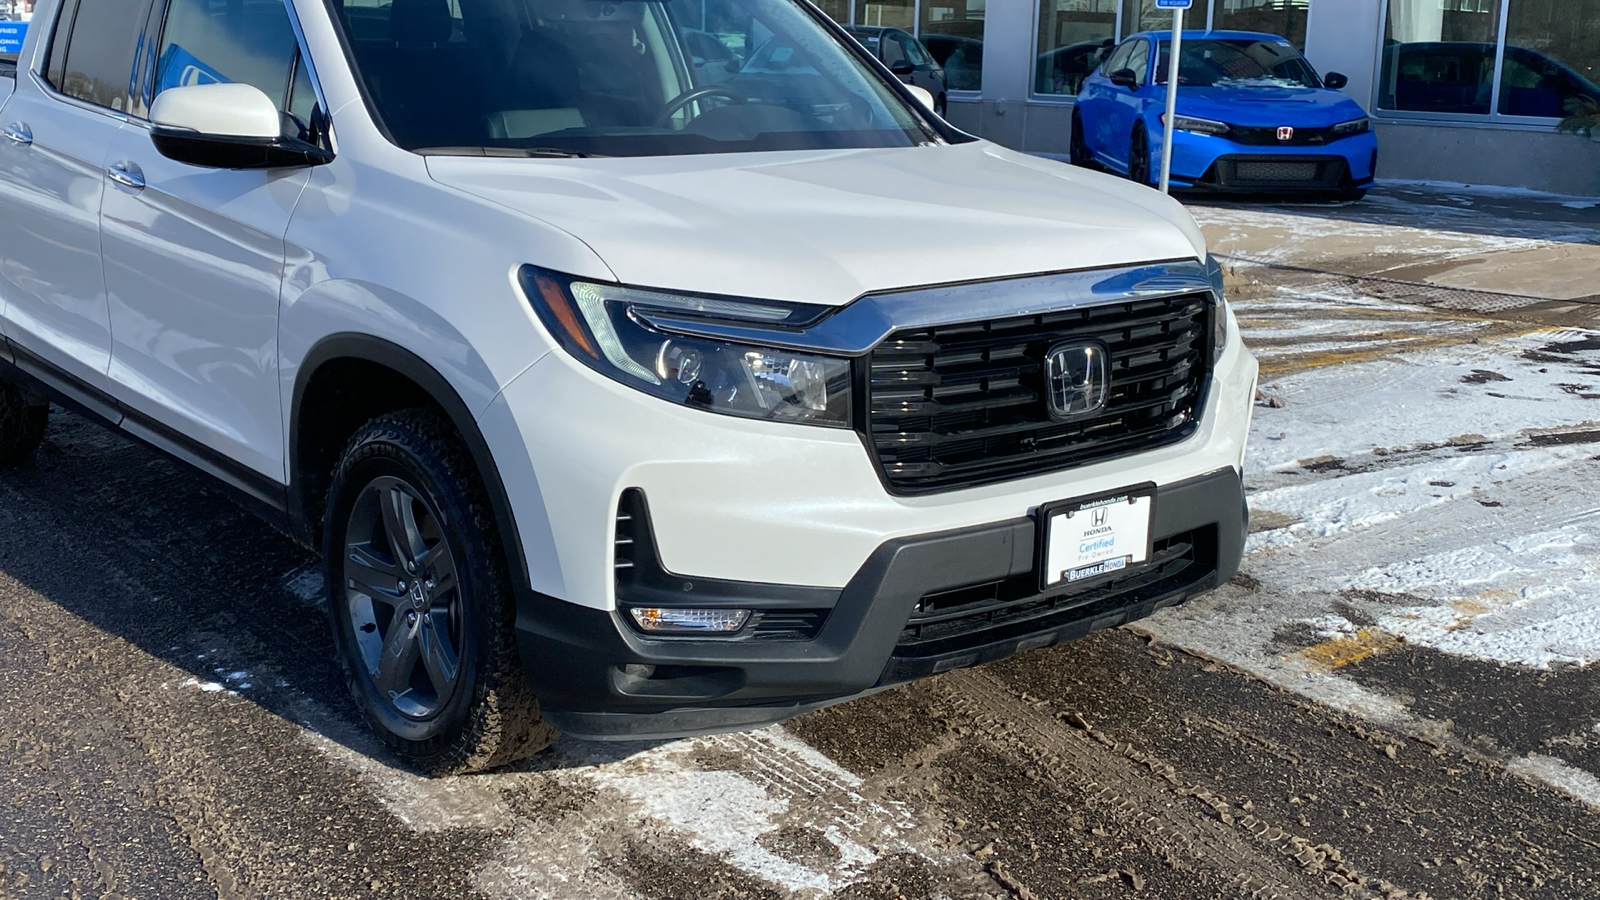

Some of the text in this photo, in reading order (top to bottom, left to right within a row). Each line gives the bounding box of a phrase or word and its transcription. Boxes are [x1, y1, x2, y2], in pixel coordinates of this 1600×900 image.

[1083, 526, 1112, 537] HONDA
[1079, 536, 1115, 553] Certified
[1070, 560, 1124, 580] BUERKLE HONDA
